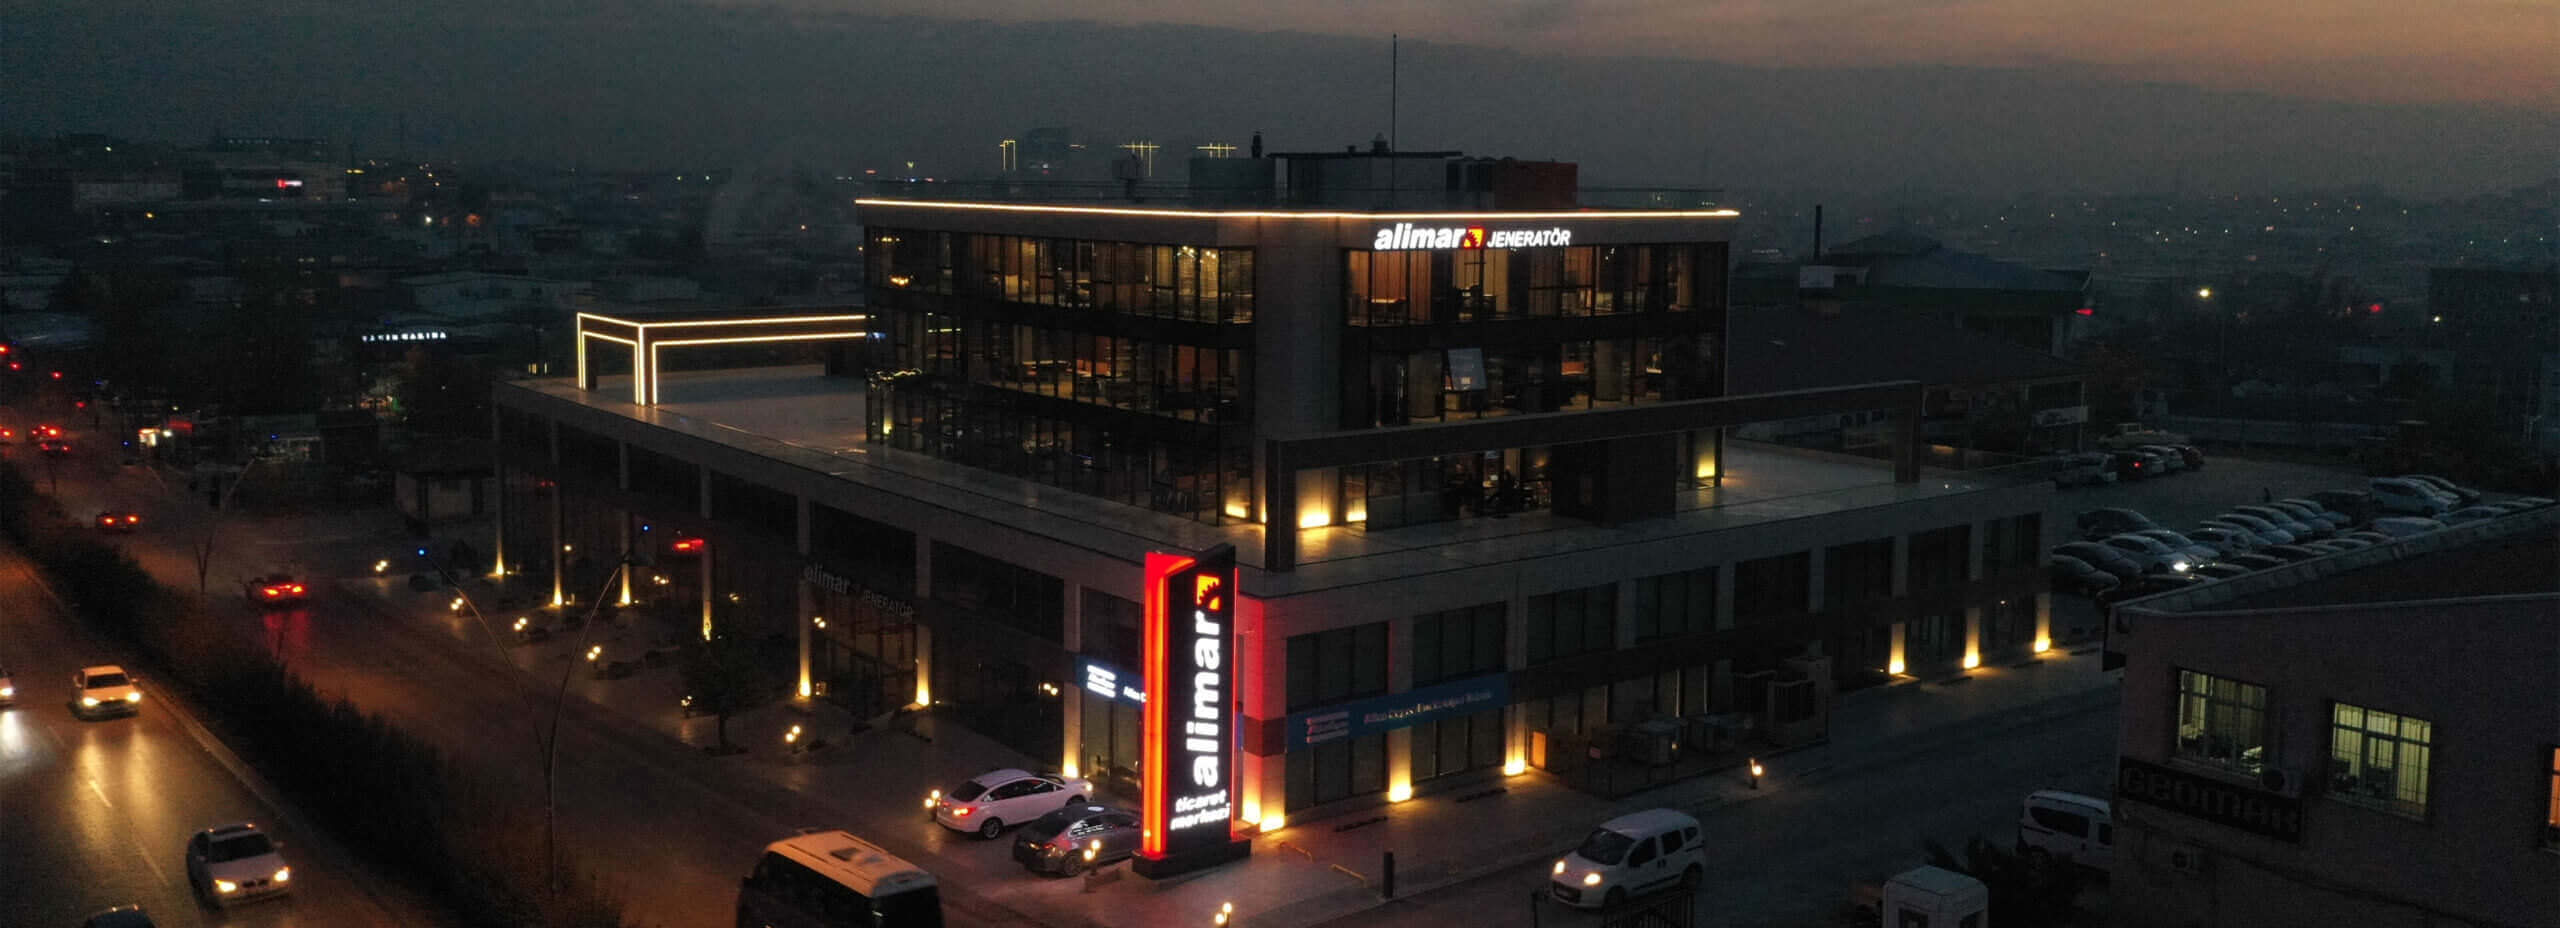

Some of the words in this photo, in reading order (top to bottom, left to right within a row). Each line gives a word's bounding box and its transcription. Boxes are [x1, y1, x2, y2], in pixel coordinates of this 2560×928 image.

[1374, 223, 1465, 250] alimar
[1486, 228, 1571, 247] JENERATÖR
[1186, 610, 1220, 788] alimar
